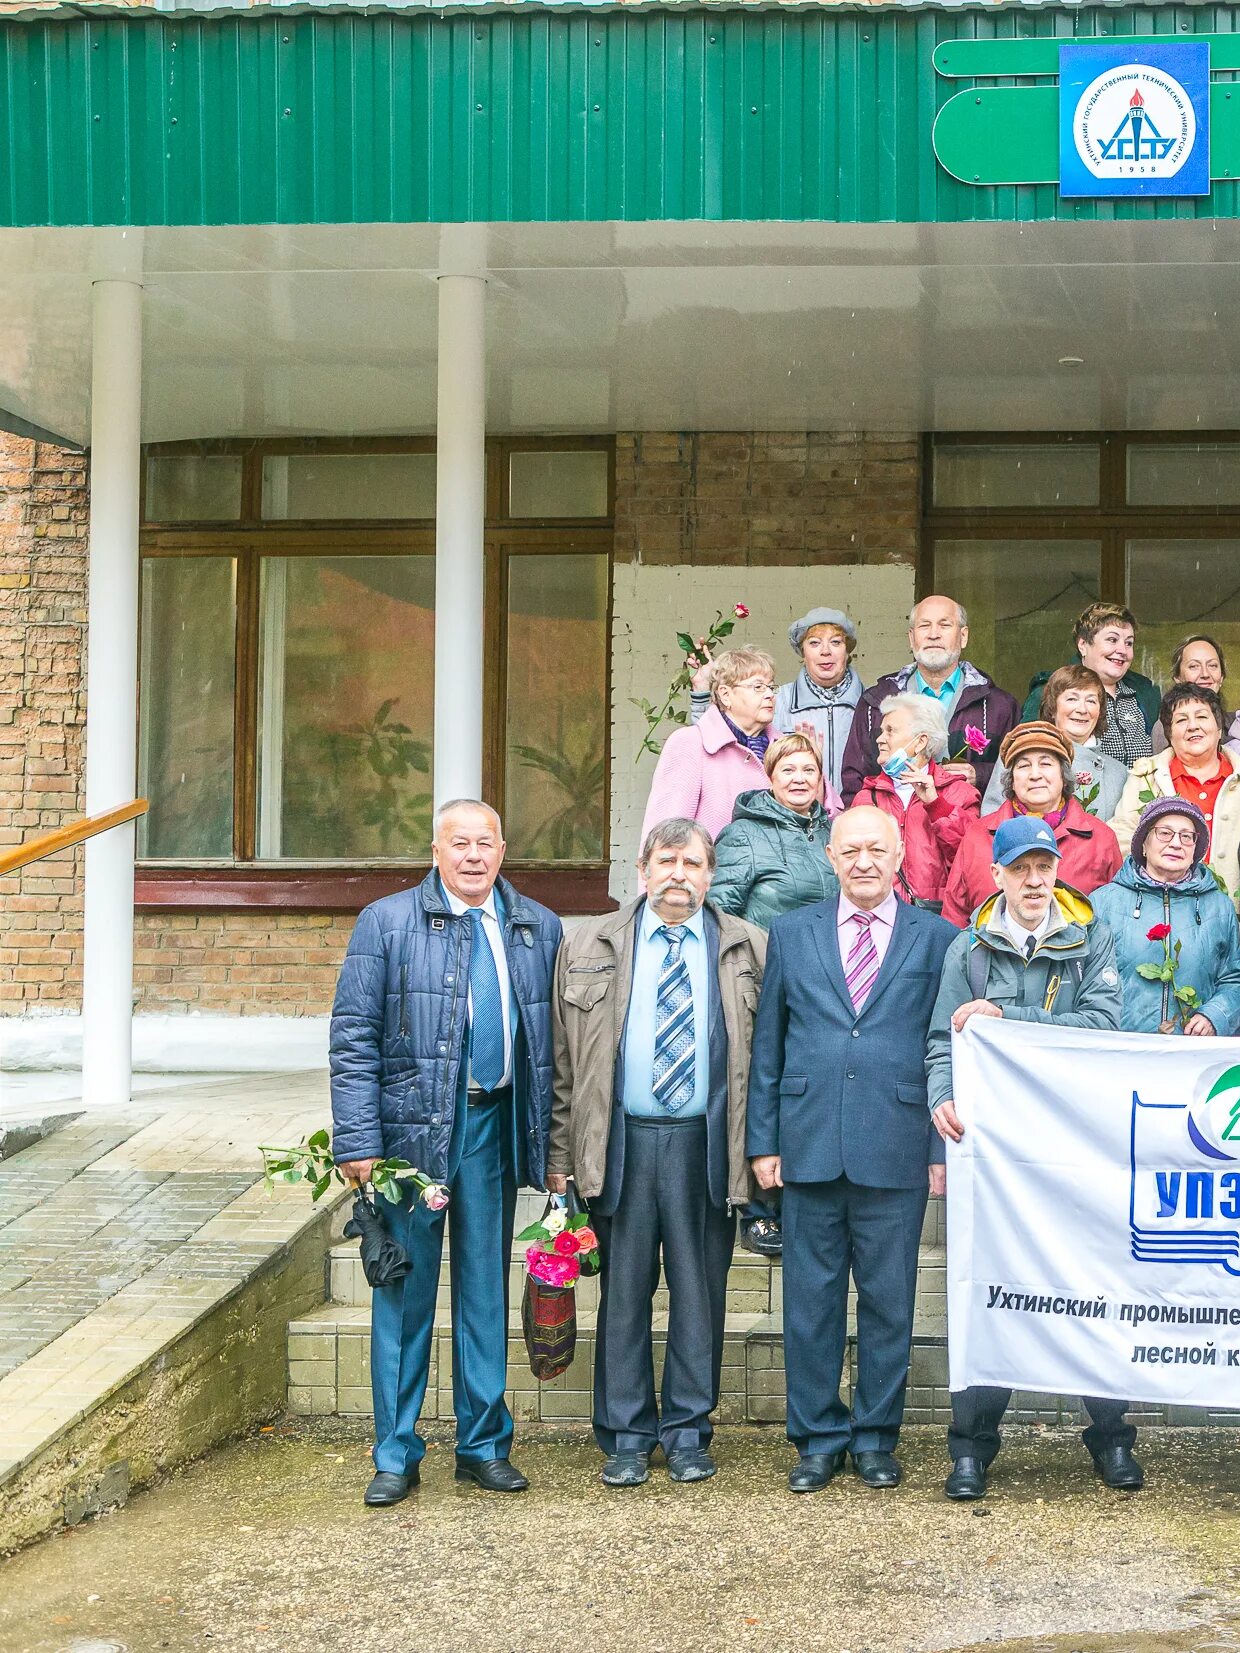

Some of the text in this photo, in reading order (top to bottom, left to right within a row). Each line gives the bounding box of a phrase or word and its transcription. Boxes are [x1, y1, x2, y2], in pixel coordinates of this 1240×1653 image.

[1081, 72, 1188, 167] УХТИНСКИЙ ГОСУДАРСТВЕННЫЙ ТЕХНИЧЕСКИЙ УНИВЕРСИТЕТ
[986, 1285, 1107, 1320] Ухтинский
[1131, 1341, 1217, 1366] лесной
